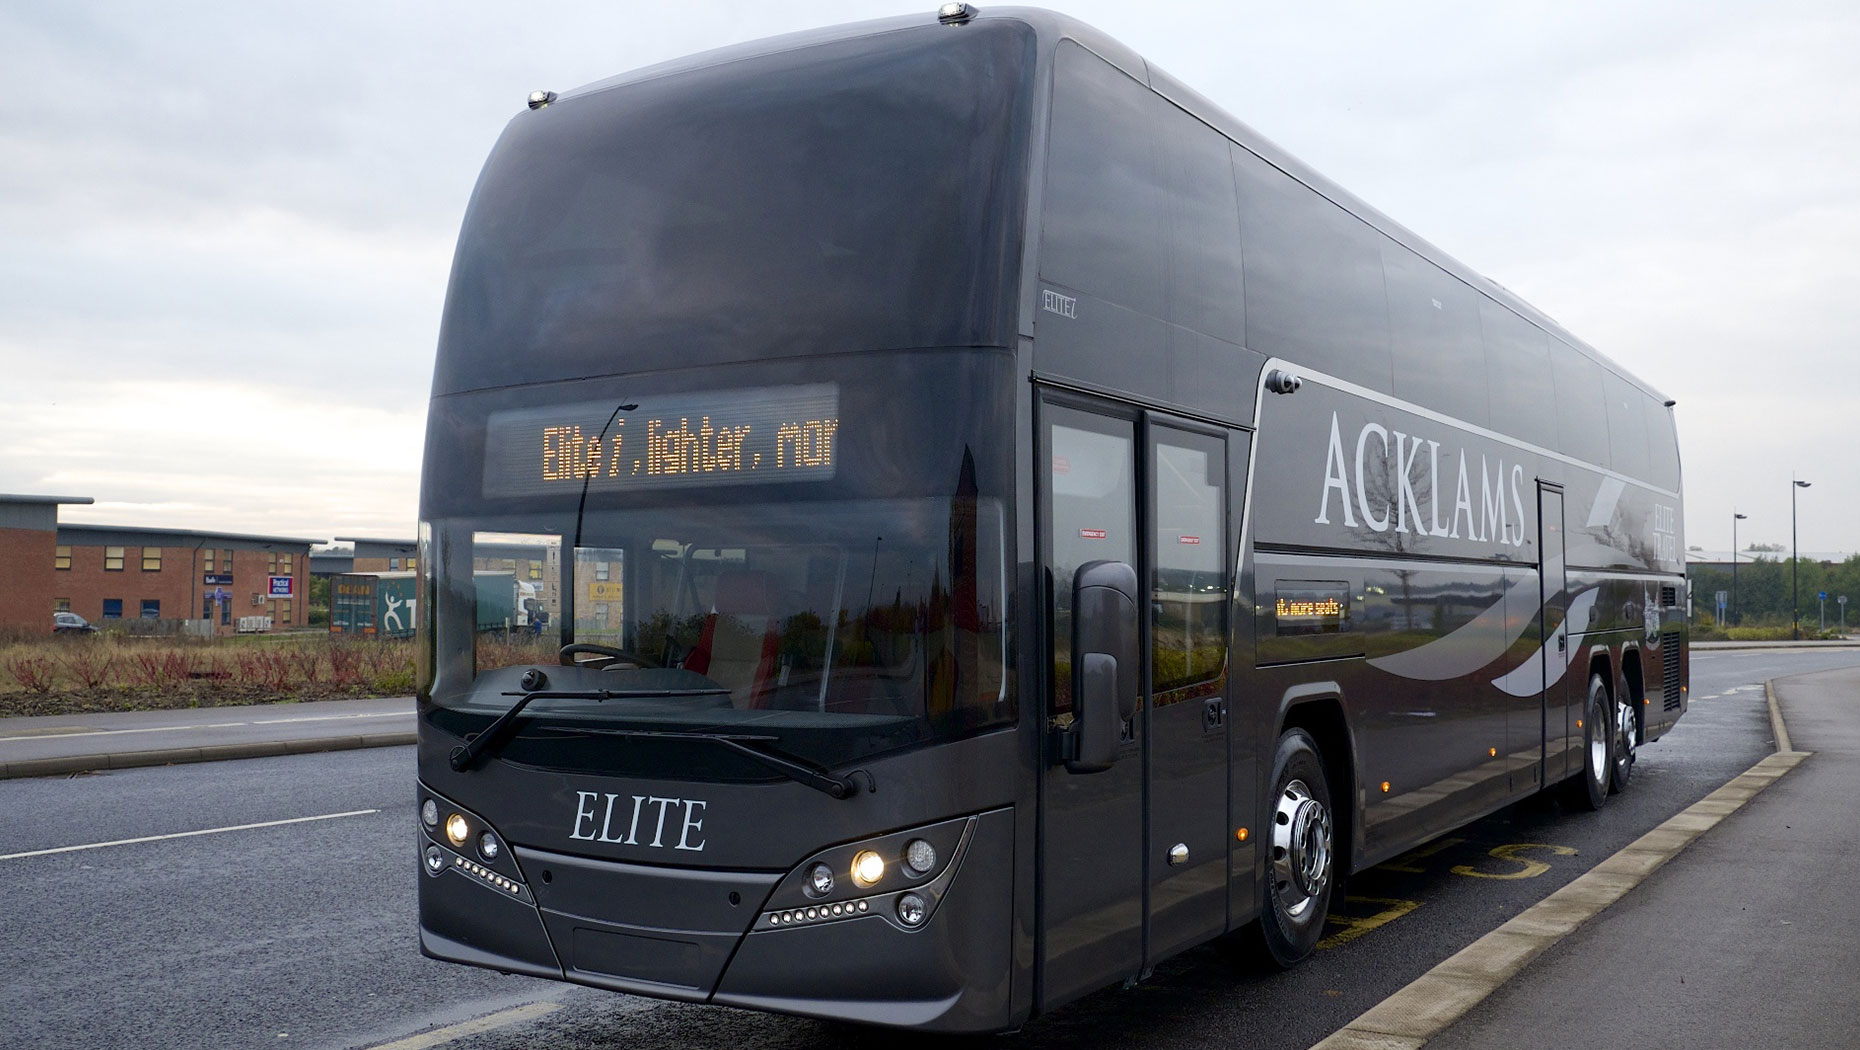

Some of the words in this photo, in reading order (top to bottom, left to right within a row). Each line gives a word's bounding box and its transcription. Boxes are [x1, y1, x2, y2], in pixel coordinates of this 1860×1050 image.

[1314, 410, 1525, 547] ACKLAMS
[1654, 503, 1674, 534] ELITE
[1315, 598, 1339, 615] seats
[568, 790, 707, 851] ELITE
